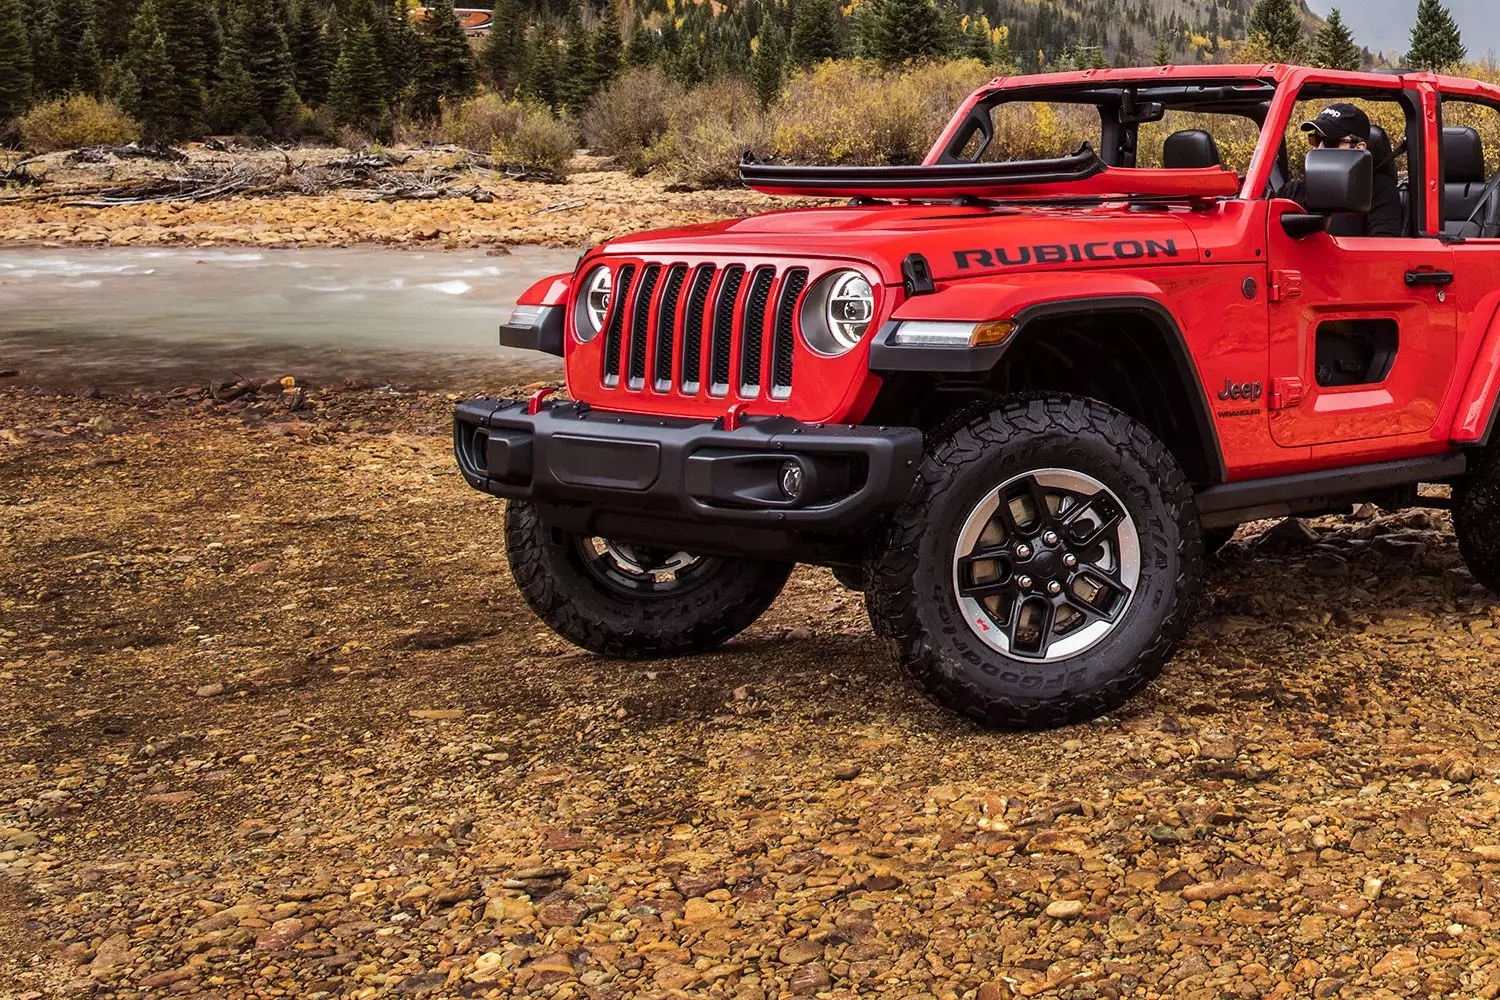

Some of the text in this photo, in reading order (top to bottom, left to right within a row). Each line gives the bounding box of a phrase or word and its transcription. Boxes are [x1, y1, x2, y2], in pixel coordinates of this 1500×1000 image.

[953, 239, 1179, 269] RUBICON
[1218, 378, 1262, 402] Jeep
[1218, 408, 1261, 418] WRANGLER
